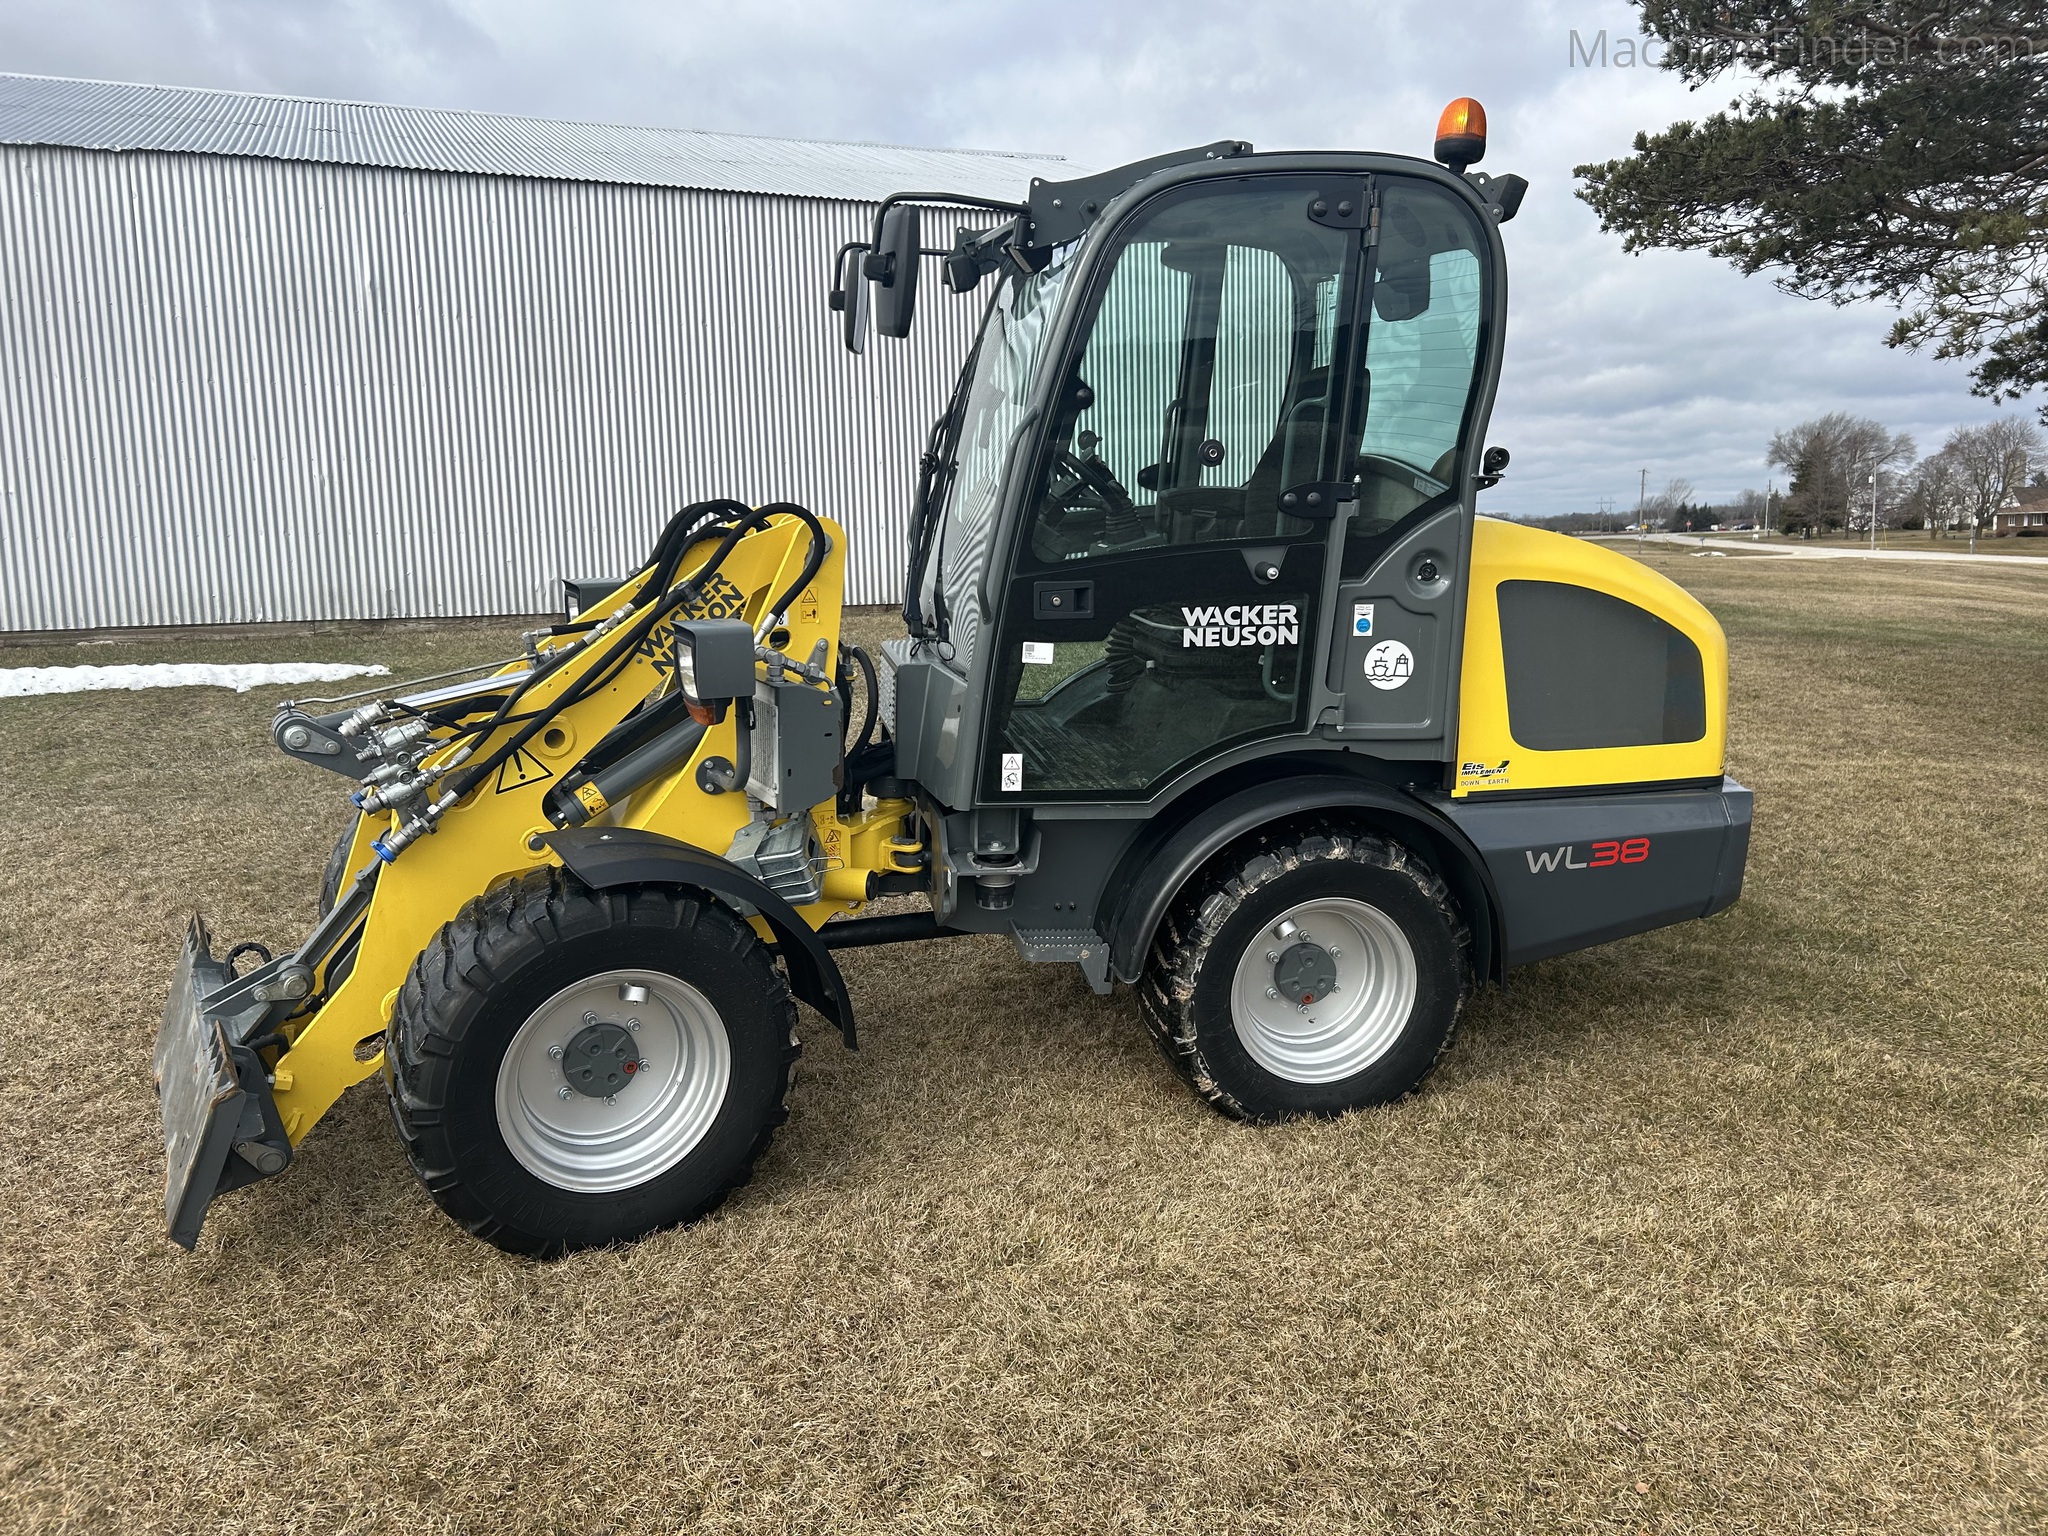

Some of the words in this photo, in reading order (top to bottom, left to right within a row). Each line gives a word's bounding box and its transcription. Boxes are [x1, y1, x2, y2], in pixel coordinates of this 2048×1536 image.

[1181, 604, 1299, 627] WACKER
[1183, 625, 1299, 648] NEUSON
[1461, 768, 1507, 776] IMPLEMENT
[1525, 837, 1650, 874] WL38
